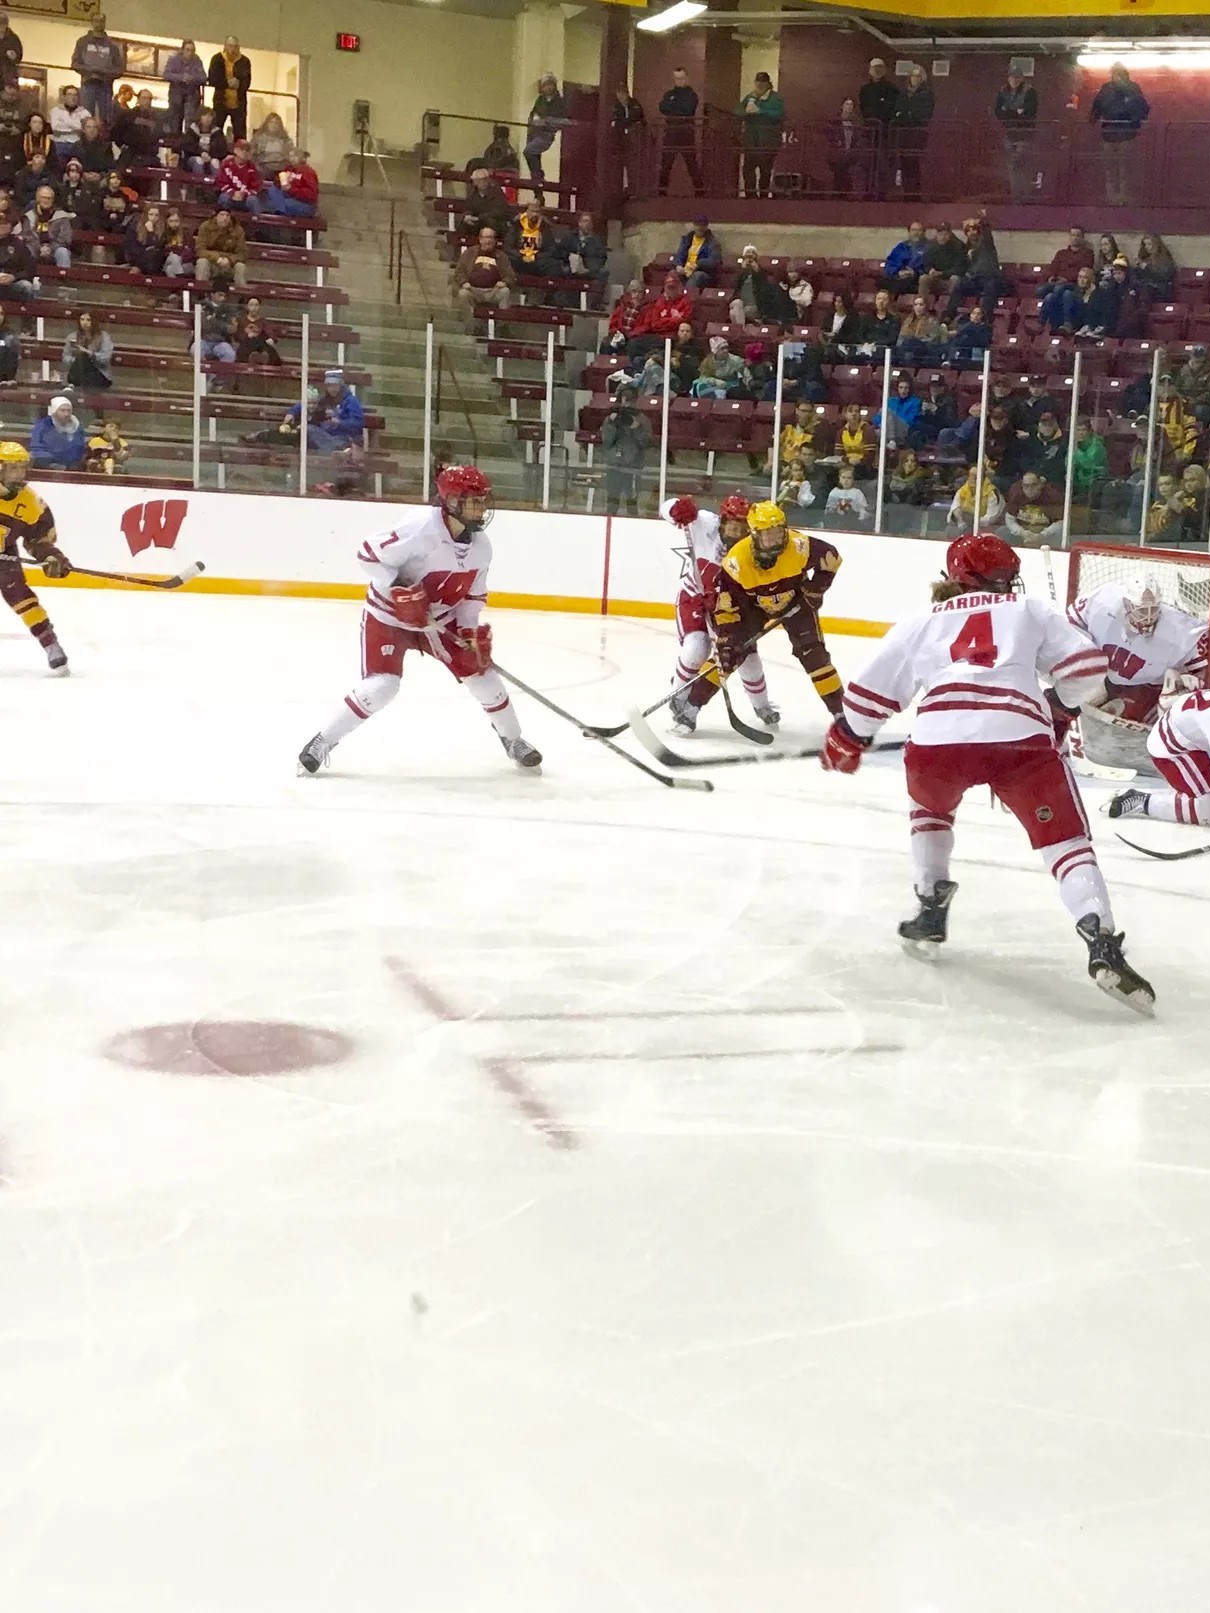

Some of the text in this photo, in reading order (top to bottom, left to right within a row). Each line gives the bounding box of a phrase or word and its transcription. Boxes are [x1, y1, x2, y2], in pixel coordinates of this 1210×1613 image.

[14, 503, 27, 518] C
[120, 499, 189, 558] W
[931, 592, 1018, 613] GARDNER
[949, 610, 998, 669] 4
